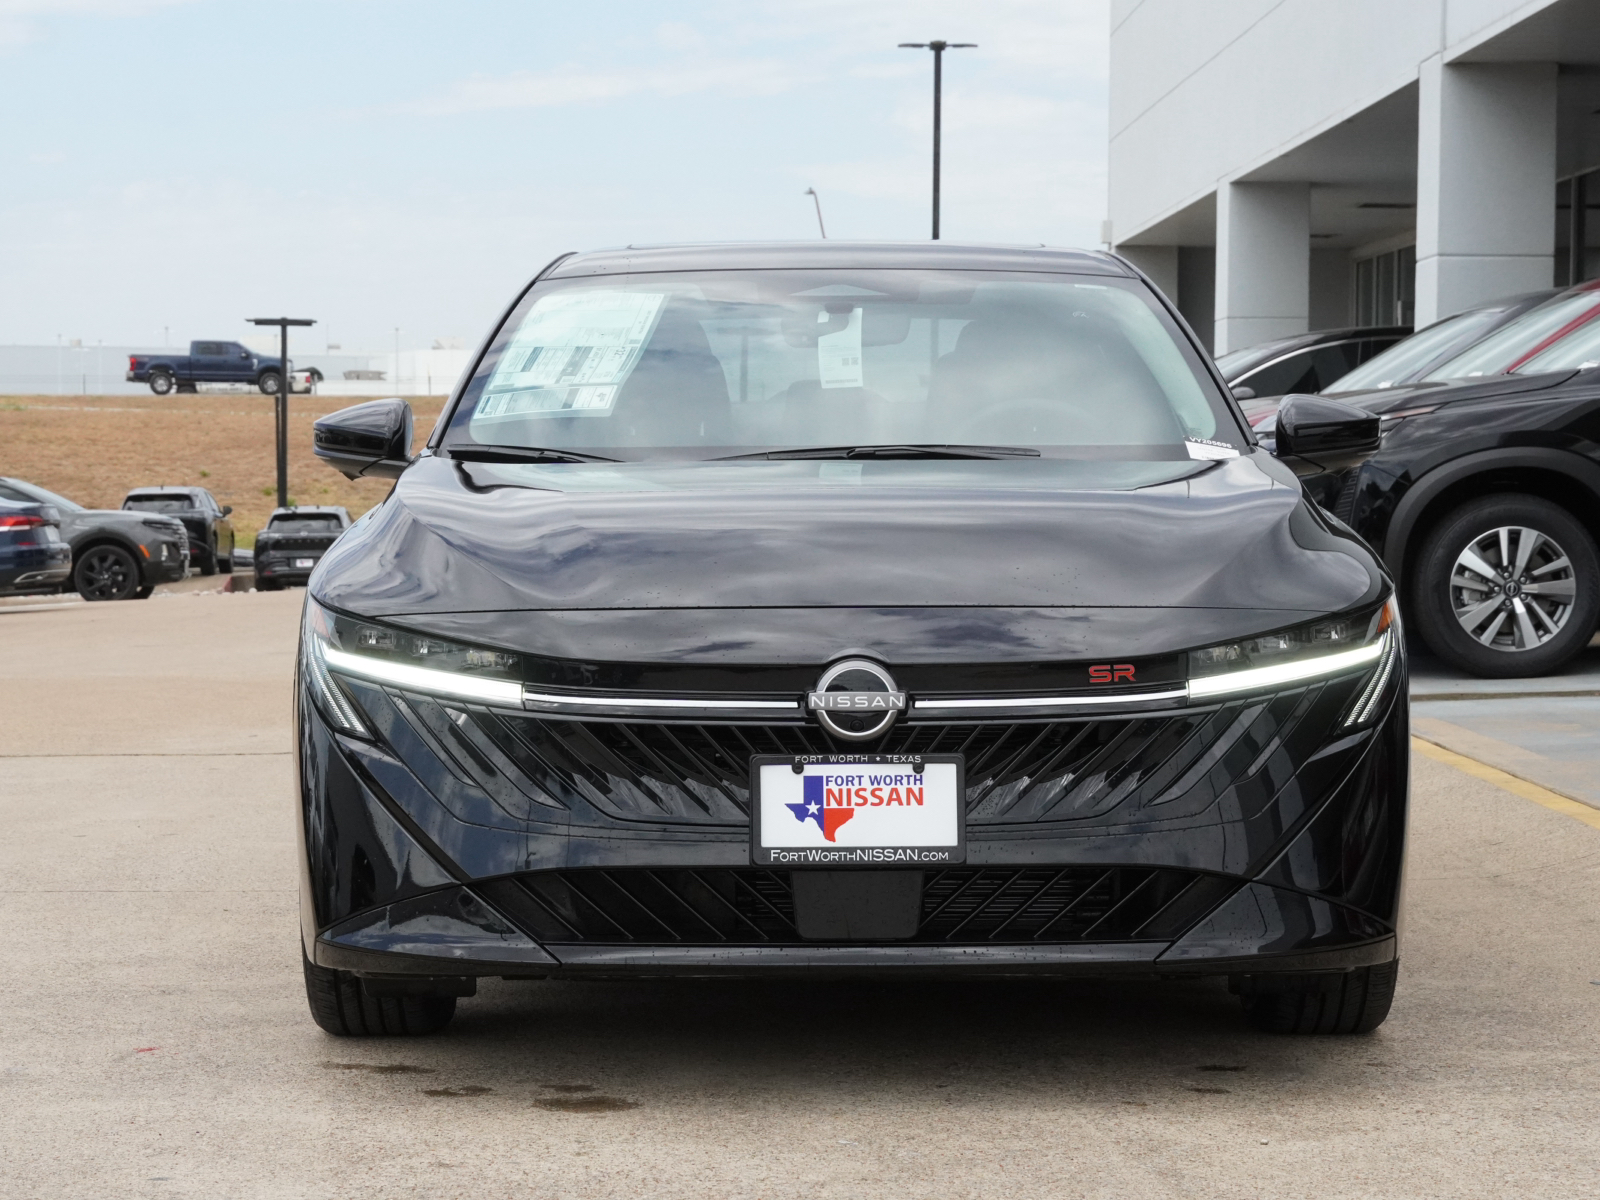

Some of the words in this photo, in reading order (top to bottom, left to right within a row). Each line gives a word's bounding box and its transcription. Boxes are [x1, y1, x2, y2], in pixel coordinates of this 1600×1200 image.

[1089, 664, 1136, 682] SR
[811, 696, 903, 707] NISSAN
[829, 755, 868, 763] WORTH
[886, 755, 922, 763] TEXAS
[825, 775, 865, 786] FORT
[869, 774, 923, 786] WORTH
[825, 787, 924, 807] NISSAN
